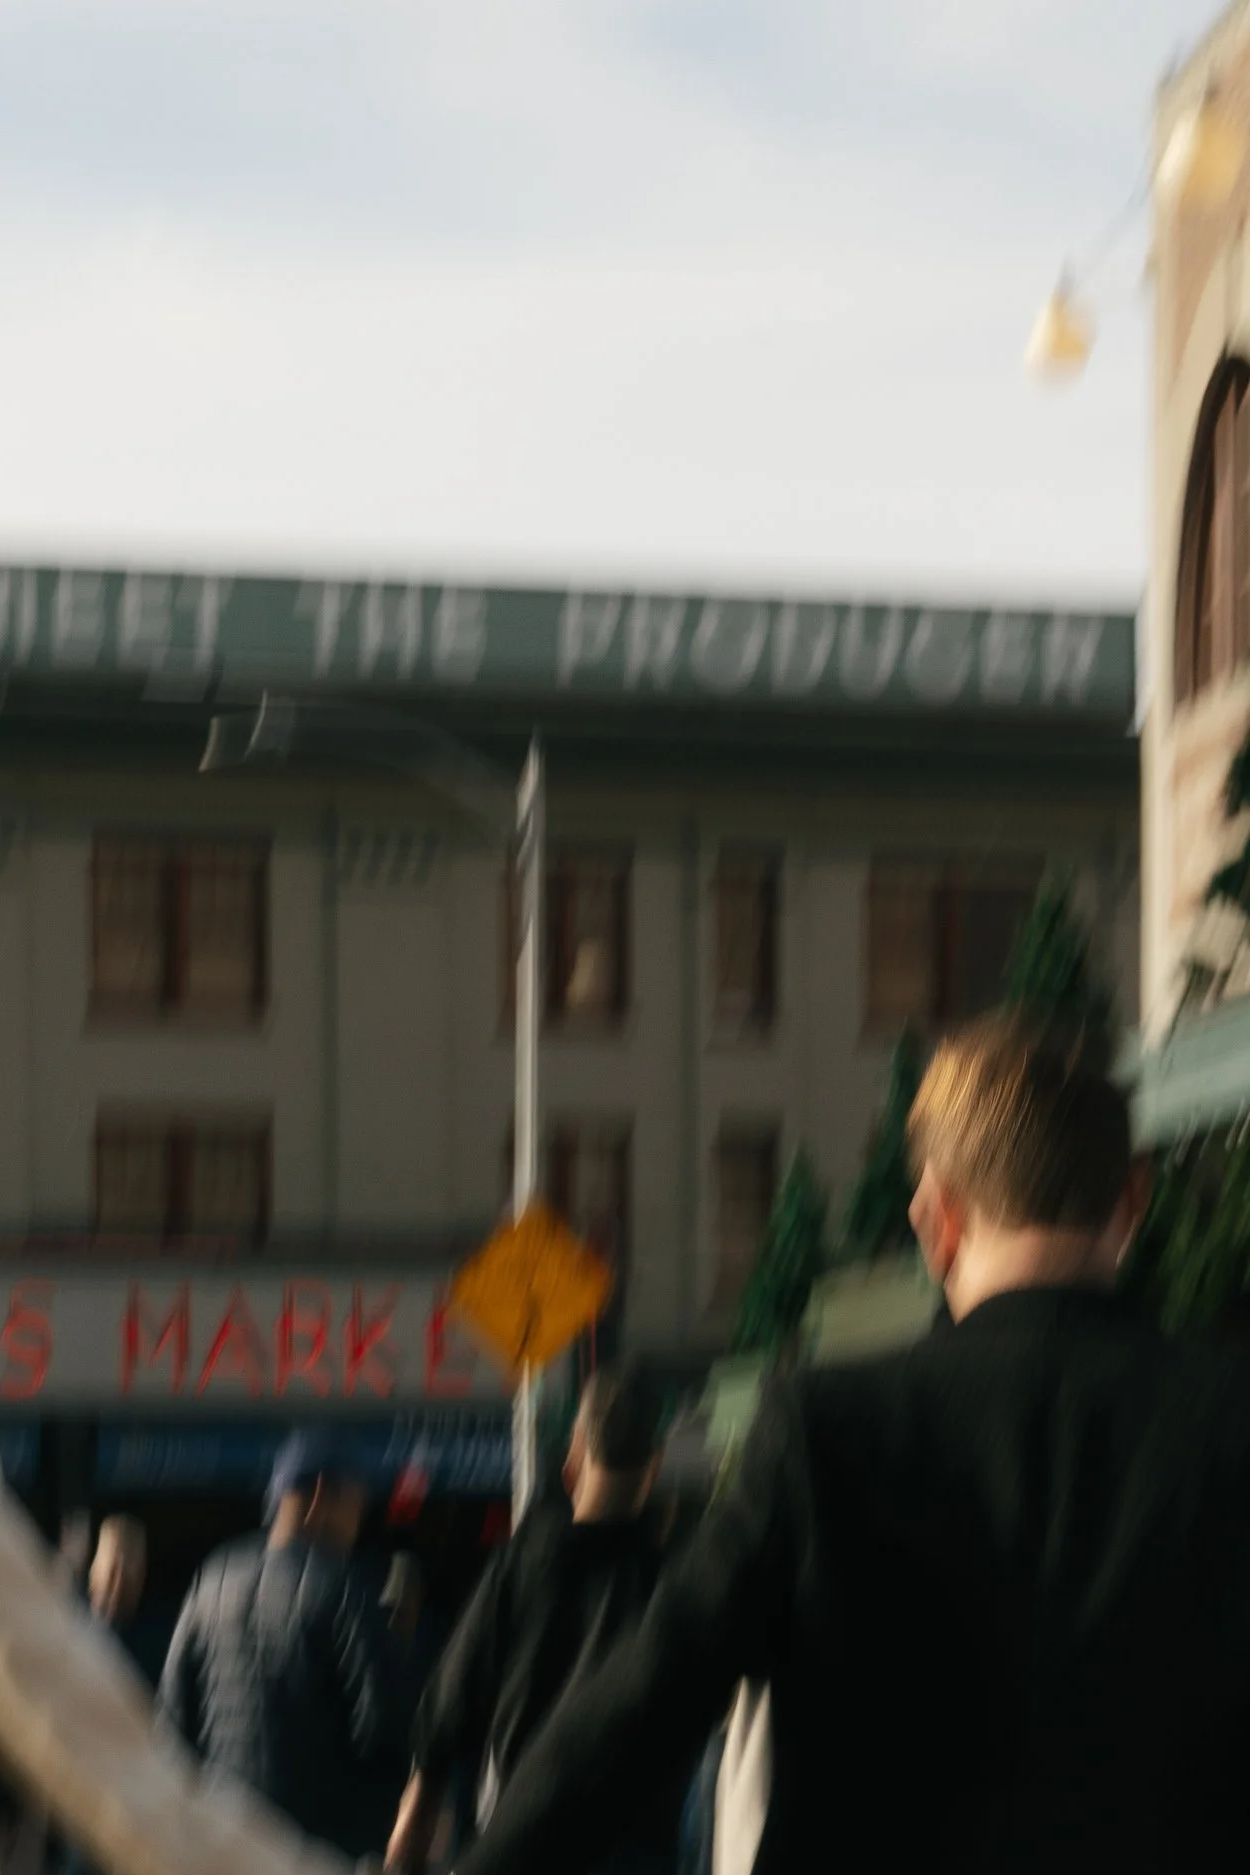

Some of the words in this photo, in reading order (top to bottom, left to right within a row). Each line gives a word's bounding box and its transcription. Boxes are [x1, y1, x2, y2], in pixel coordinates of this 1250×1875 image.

[295, 576, 488, 686] THE
[553, 585, 1103, 704] PRODUCER
[118, 1277, 476, 1402] MARKE
